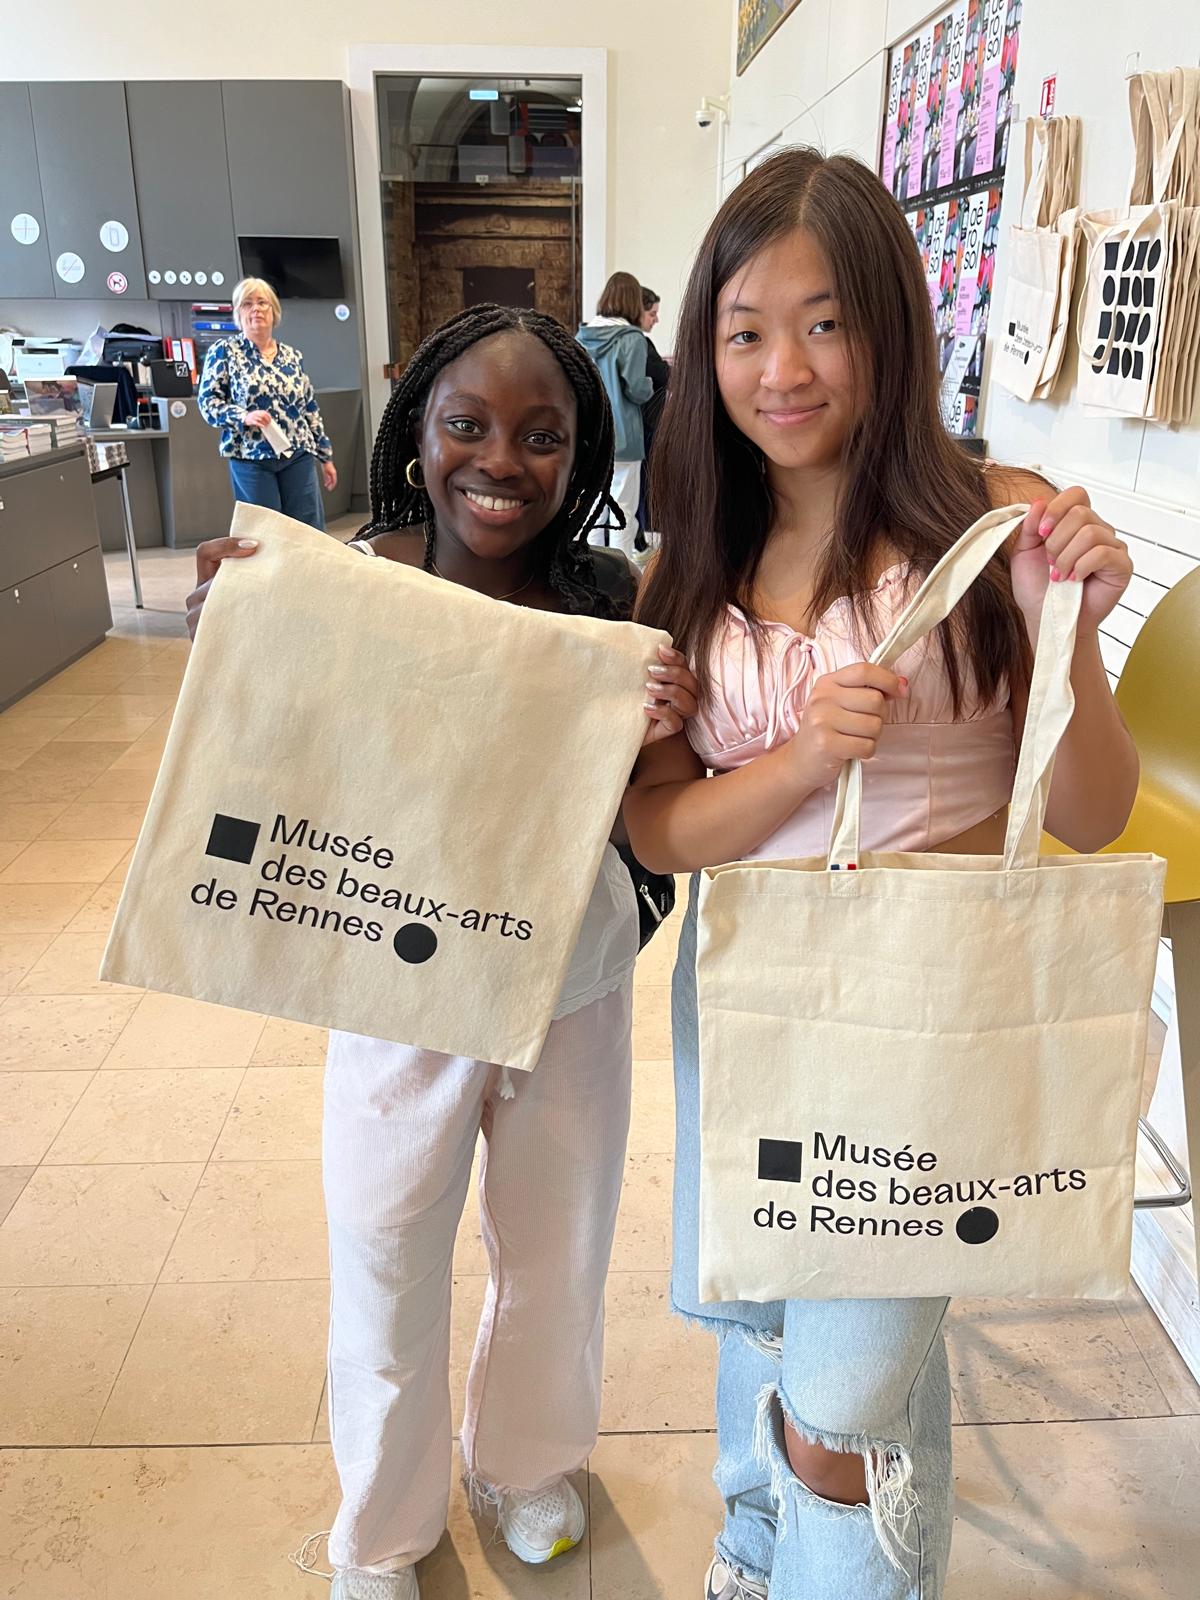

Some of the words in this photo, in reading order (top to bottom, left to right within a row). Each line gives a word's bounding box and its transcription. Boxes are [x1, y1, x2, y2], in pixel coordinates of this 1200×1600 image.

[270, 813, 395, 870] Musée
[190, 878, 238, 911] de
[248, 887, 385, 943] Rennes
[260, 853, 328, 891] des
[336, 867, 534, 942] beaux-arts
[812, 1131, 938, 1172] Musée
[811, 1169, 878, 1203] des
[888, 1167, 1087, 1207] beaux-arts
[753, 1200, 798, 1230] de
[809, 1204, 944, 1237] Rennes
